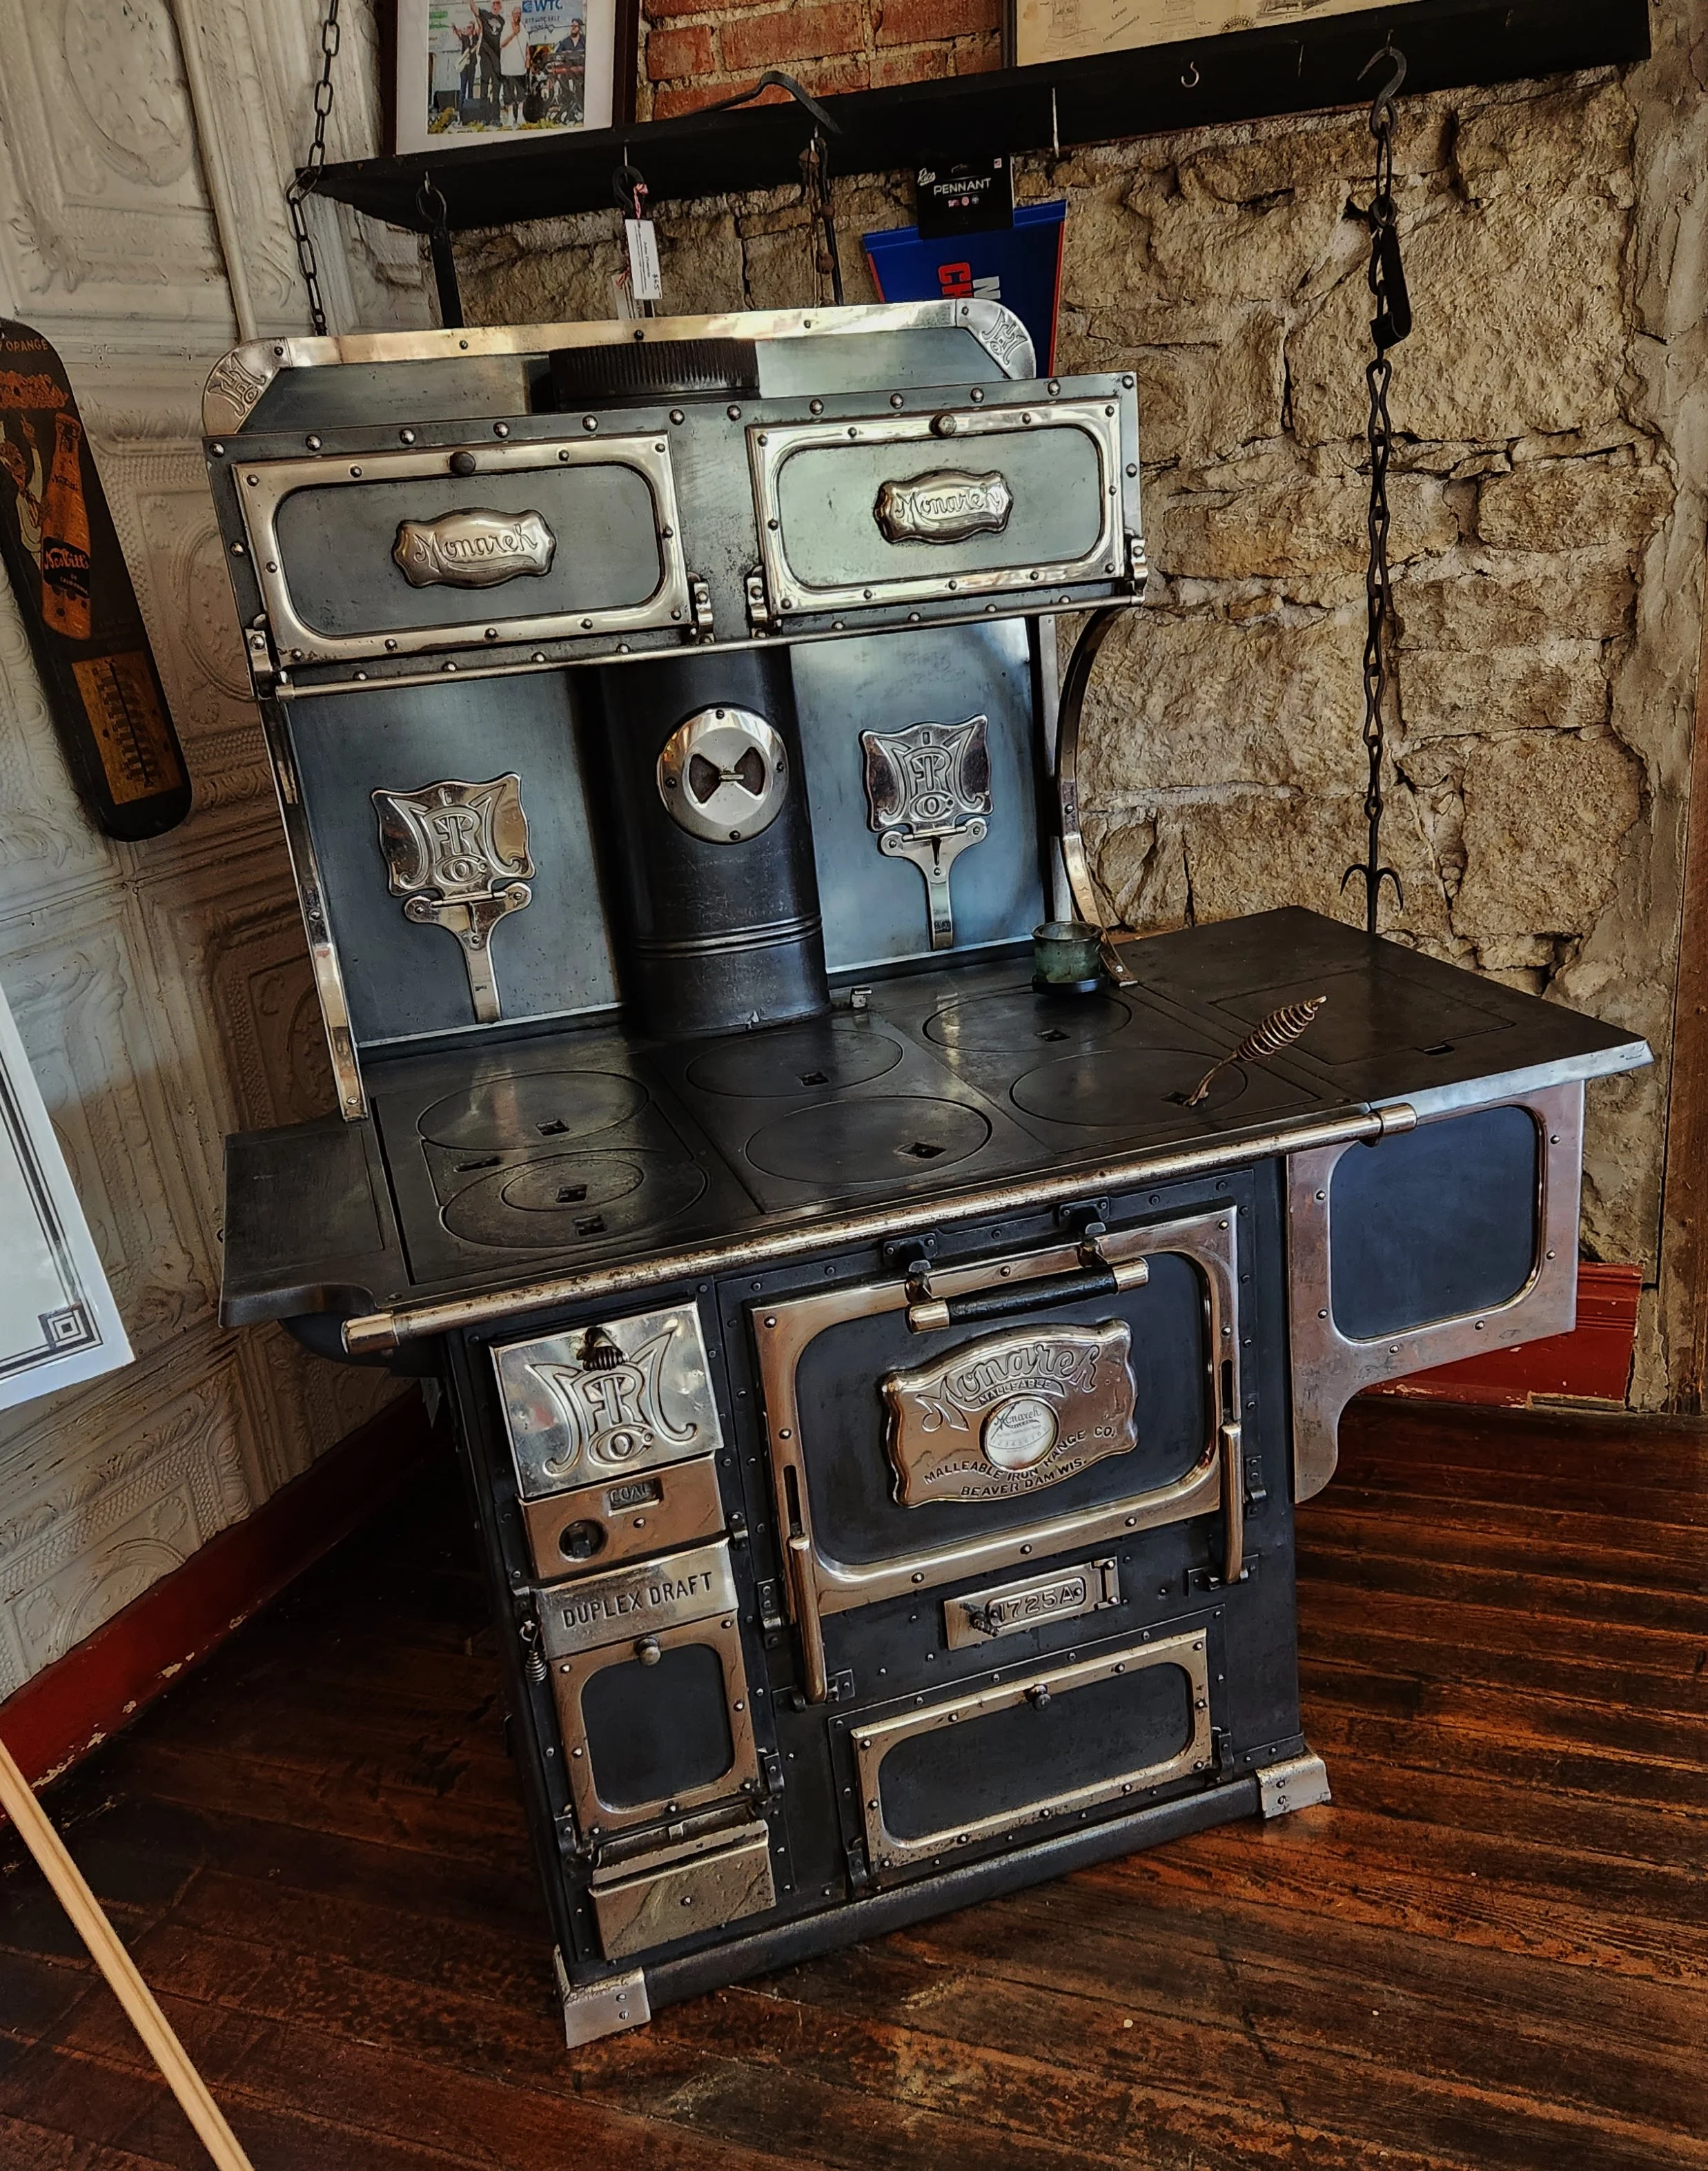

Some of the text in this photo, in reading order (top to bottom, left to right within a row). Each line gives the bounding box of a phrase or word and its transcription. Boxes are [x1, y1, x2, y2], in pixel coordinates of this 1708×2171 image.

[933, 177, 992, 196] PENNANT
[6, 338, 49, 352] ORANGE
[414, 523, 538, 574] Monarch
[915, 1343, 1101, 1432] Monarch
[978, 1379, 1052, 1405] MALLEABLE
[923, 1460, 1004, 1485] MALLEABLE
[1006, 1468, 1039, 1483] IRON
[961, 1457, 1088, 1497] BEAVER DAM WIS.
[562, 1571, 714, 1630] DUPLEX DRAFT
[999, 1586, 1075, 1622] 1725A
